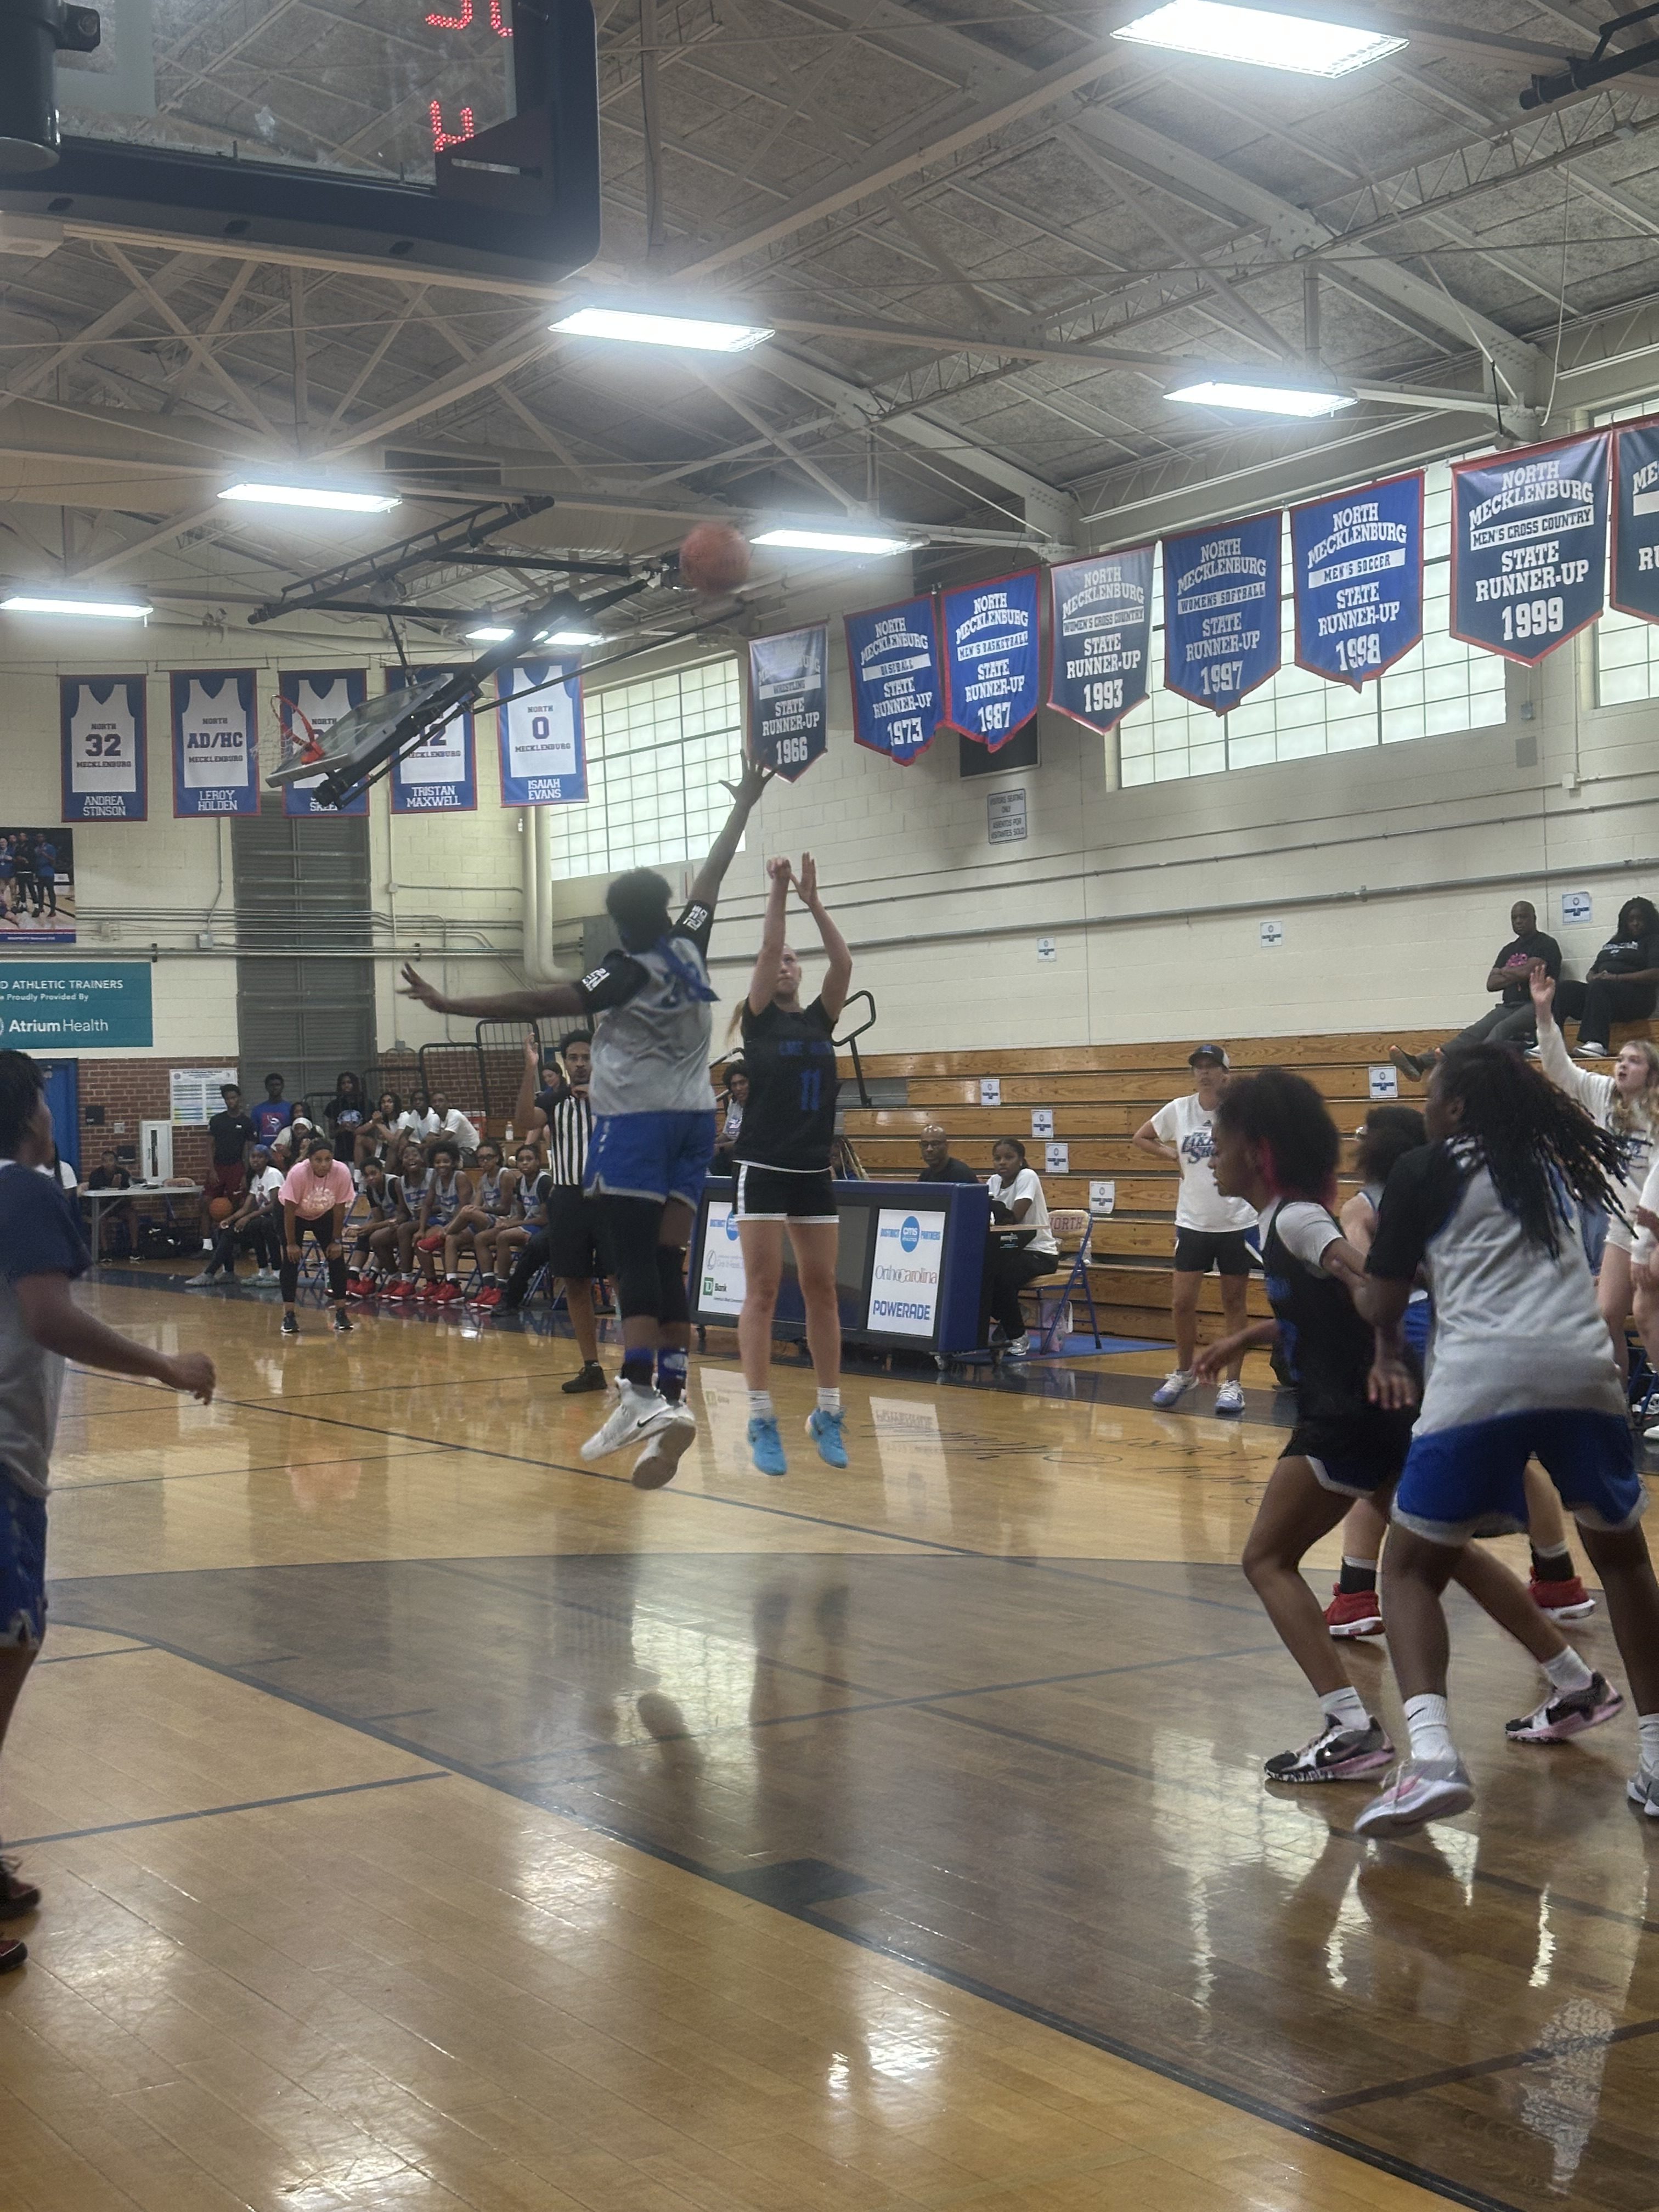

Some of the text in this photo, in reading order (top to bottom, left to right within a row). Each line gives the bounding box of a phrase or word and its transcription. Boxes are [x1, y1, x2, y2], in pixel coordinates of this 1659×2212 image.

[1502, 460, 1560, 492] NORTH
[1332, 503, 1379, 531] NORTH
[1469, 479, 1594, 532] MECKLENBURG
[1472, 510, 1592, 548] MEN'S CROSS COUNTRY
[1200, 538, 1242, 563] NORTH
[1307, 522, 1407, 569] MECKLENBURG
[1501, 540, 1560, 573] STATE
[1357, 554, 1391, 573] SOCCER
[1084, 566, 1121, 588] NORTH
[1177, 557, 1267, 596] MECKLENBURG
[1475, 559, 1589, 602] RUNNER-UP
[974, 592, 1008, 614] NORTH
[1063, 583, 1144, 619] MECKLENBURG
[1221, 584, 1264, 603] SOFTBALL
[1336, 582, 1380, 610] STATE
[875, 617, 906, 638] NORTH
[956, 609, 1029, 645] MECKLENBURG
[1201, 612, 1242, 637] STATE
[1318, 601, 1400, 636] RUNNER-UP
[1502, 596, 1564, 641] 1999
[861, 633, 928, 665] MECKLENBURG
[1084, 633, 1121, 656] STATE
[1186, 631, 1260, 662] RUNNER-UP
[1335, 634, 1381, 671] 1998
[977, 658, 1009, 680] STATE
[1066, 650, 1141, 679] RUNNER-UP
[883, 676, 915, 698] STATE
[965, 675, 1025, 703] RUNNER-UP
[1200, 661, 1243, 695] 1997
[775, 697, 805, 716] STATE
[872, 691, 933, 718] RUNNER-UP
[1084, 679, 1123, 713] 1993
[532, 716, 550, 740] 0
[762, 712, 820, 736] RUNNER-UP
[978, 702, 1012, 732] 1987
[187, 732, 242, 748] AD/HC
[887, 717, 923, 746] 1973
[85, 733, 121, 756] 32
[515, 743, 571, 752] MECKLENBURG
[776, 737, 808, 765] 1966
[200, 790, 234, 800] LEROY
[411, 786, 455, 797] TRISTAN
[528, 778, 560, 789] ISAIAH
[528, 789, 561, 800] EVANS
[83, 806, 126, 816] STINSON
[84, 795, 123, 806] ANDREA
[198, 800, 237, 811] HOLDEN
[407, 795, 461, 808] MAXWELL
[12, 980, 66, 989] ATHLETIC
[69, 980, 123, 989] TRAINERS
[7, 993, 37, 1002] Proudly
[78, 993, 89, 1002] By
[9, 1019, 109, 1032] Atrium Health
[873, 1300, 931, 1321] POWERADE
